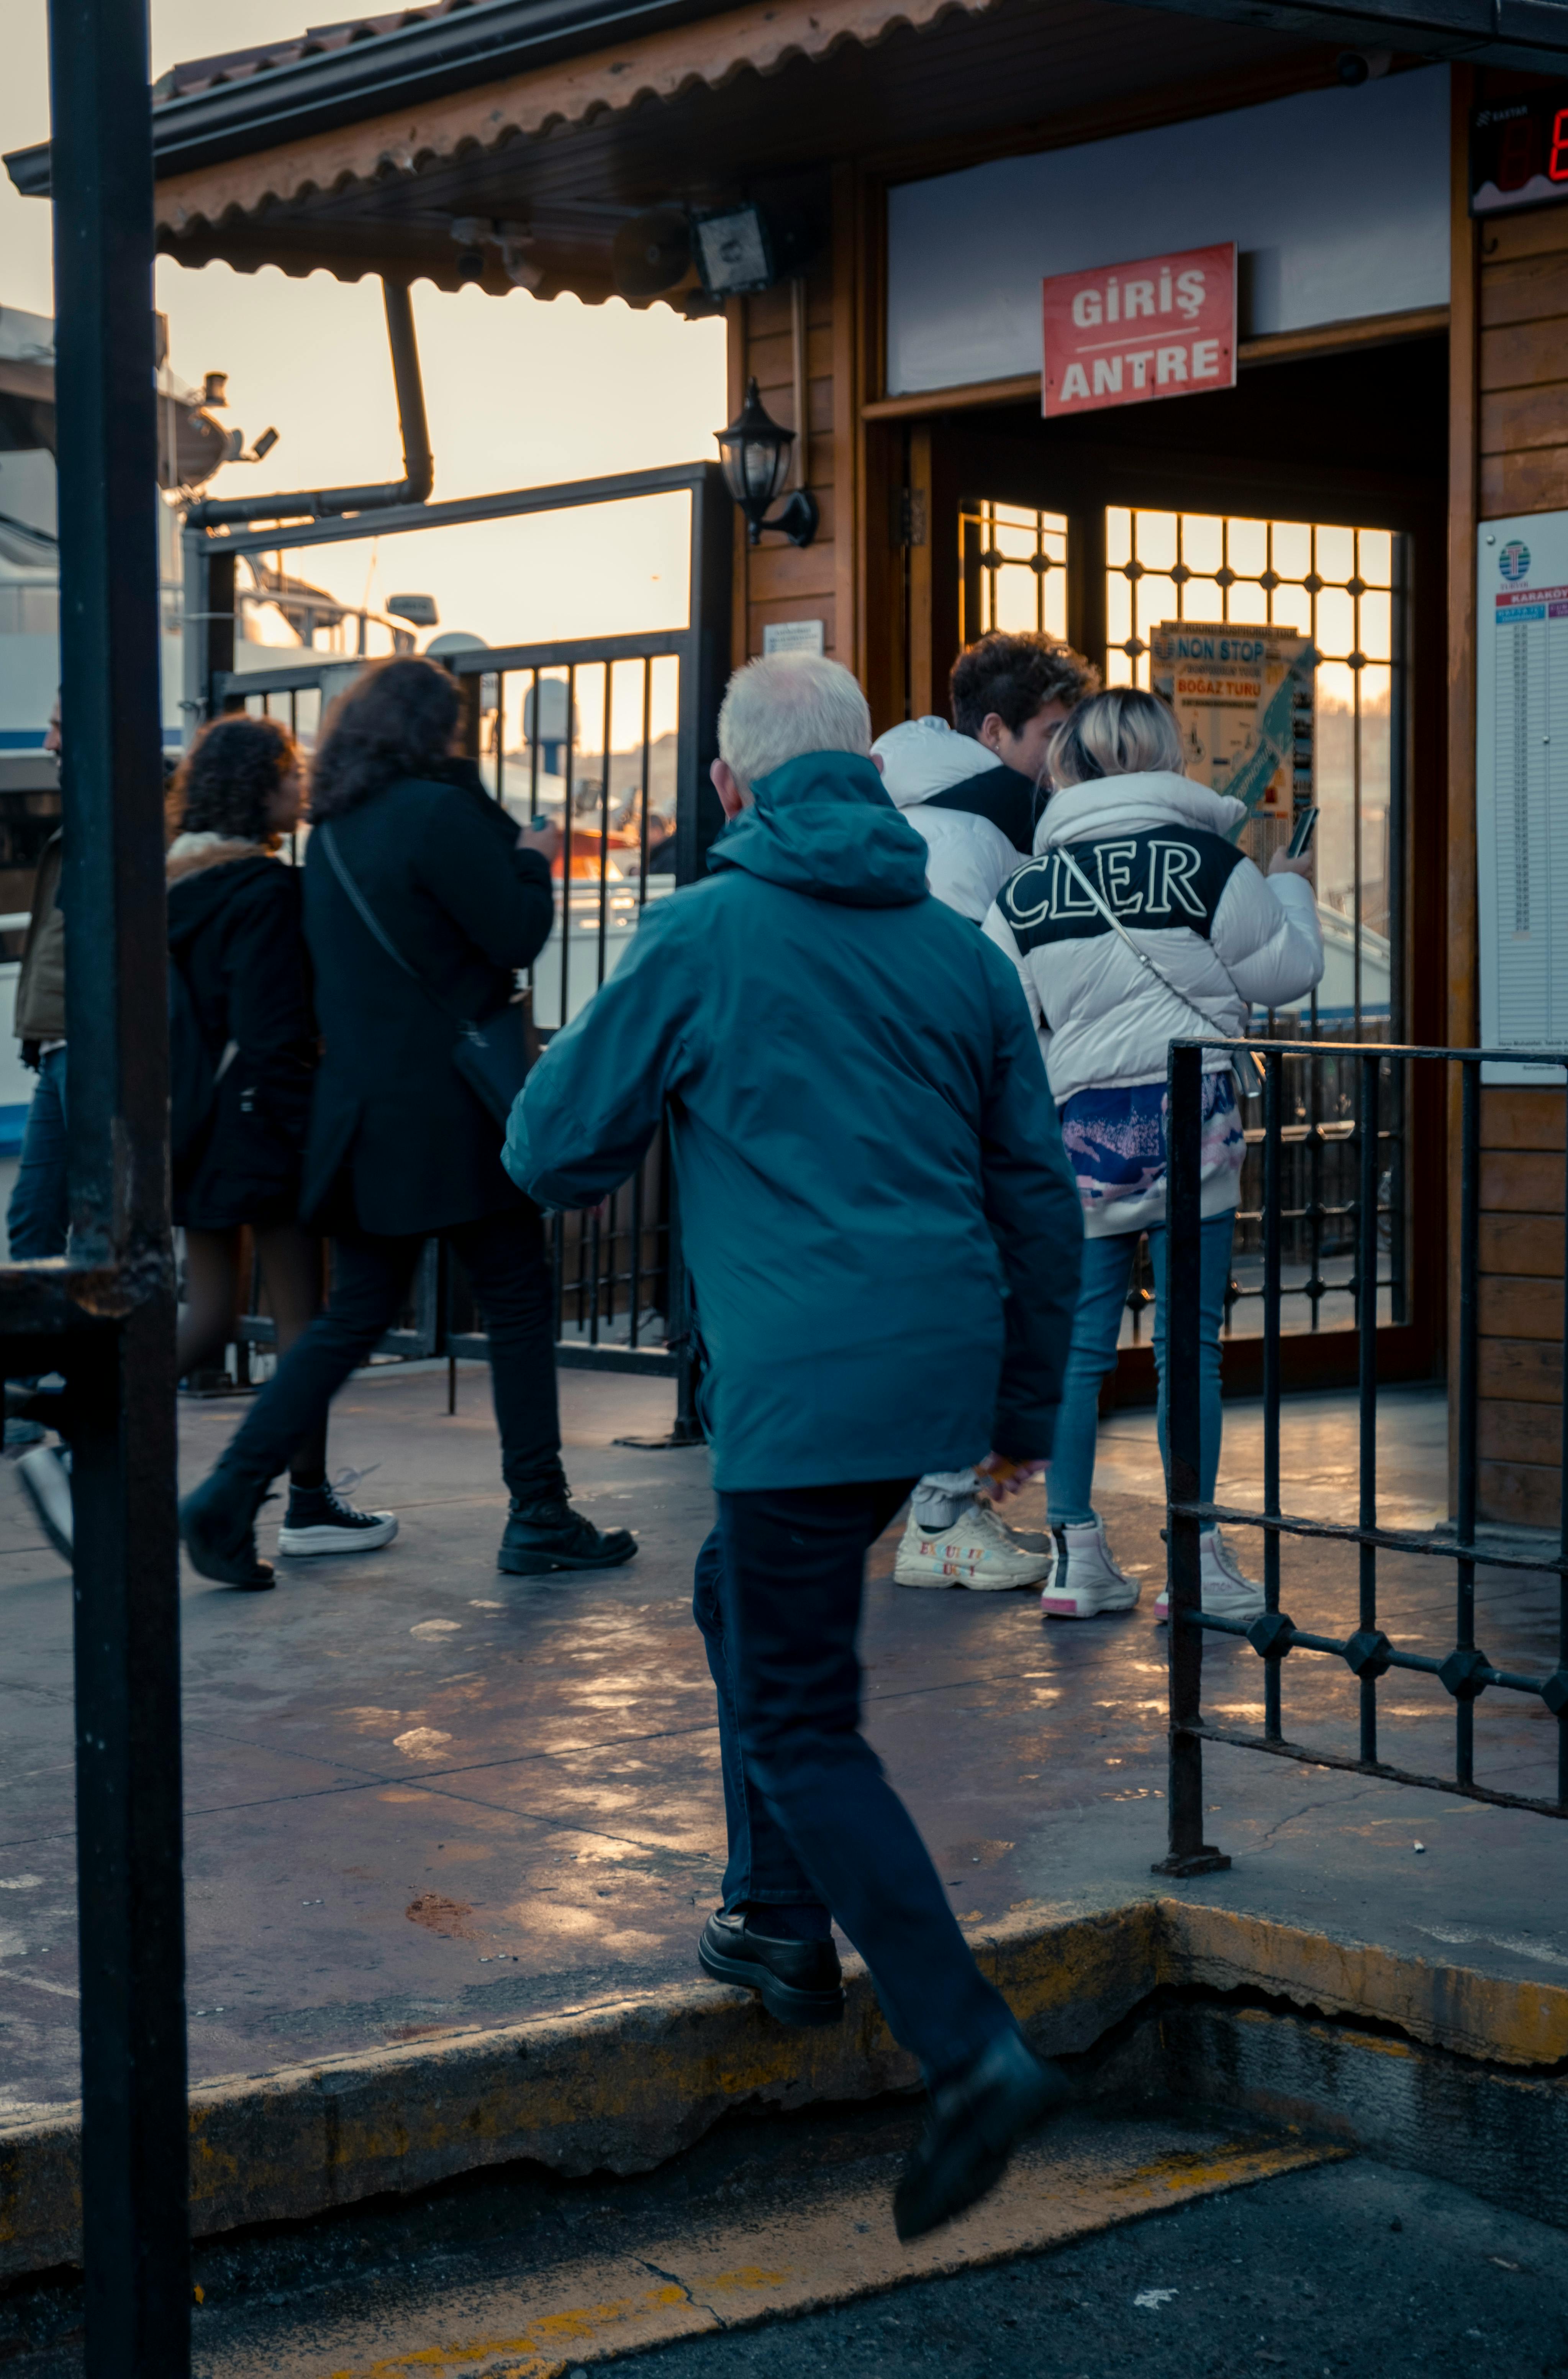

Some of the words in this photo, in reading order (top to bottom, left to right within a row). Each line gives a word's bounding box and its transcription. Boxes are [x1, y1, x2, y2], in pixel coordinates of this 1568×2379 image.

[1072, 266, 1206, 328] GİRİŞ
[1059, 339, 1219, 402] ANTRE
[1178, 638, 1214, 659] NON
[1220, 640, 1263, 661] STOP
[1178, 677, 1223, 695] BOĞAZ
[1227, 681, 1261, 697] TURU
